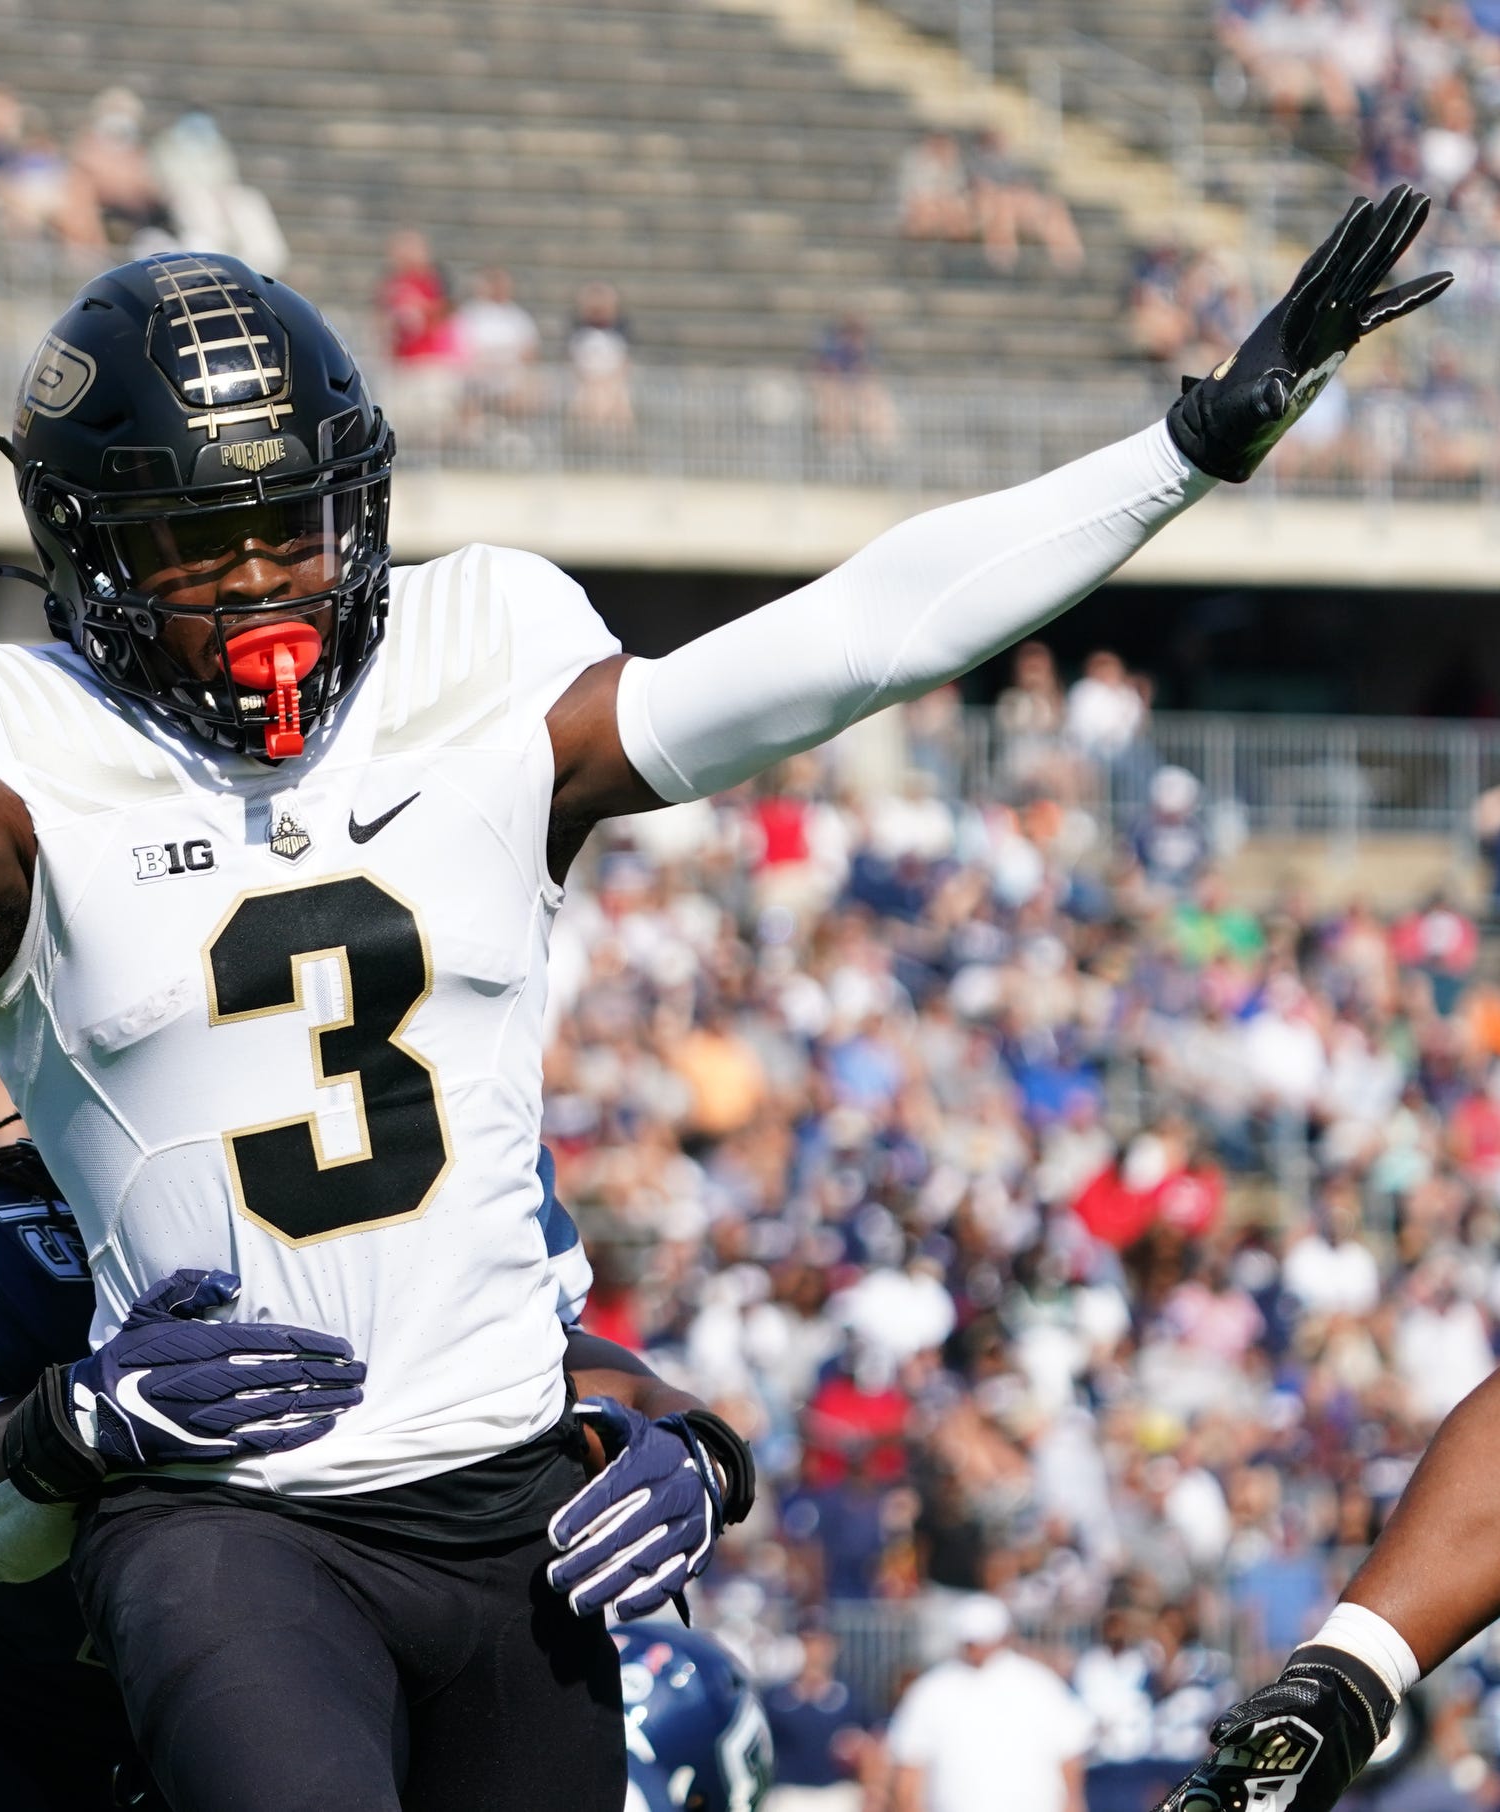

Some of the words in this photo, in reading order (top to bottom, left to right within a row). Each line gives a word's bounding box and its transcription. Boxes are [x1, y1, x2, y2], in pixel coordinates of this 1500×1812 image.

[14, 331, 98, 438] P
[220, 438, 287, 473] PURDUE
[271, 834, 310, 857] PURDUE
[200, 867, 457, 1250] 3
